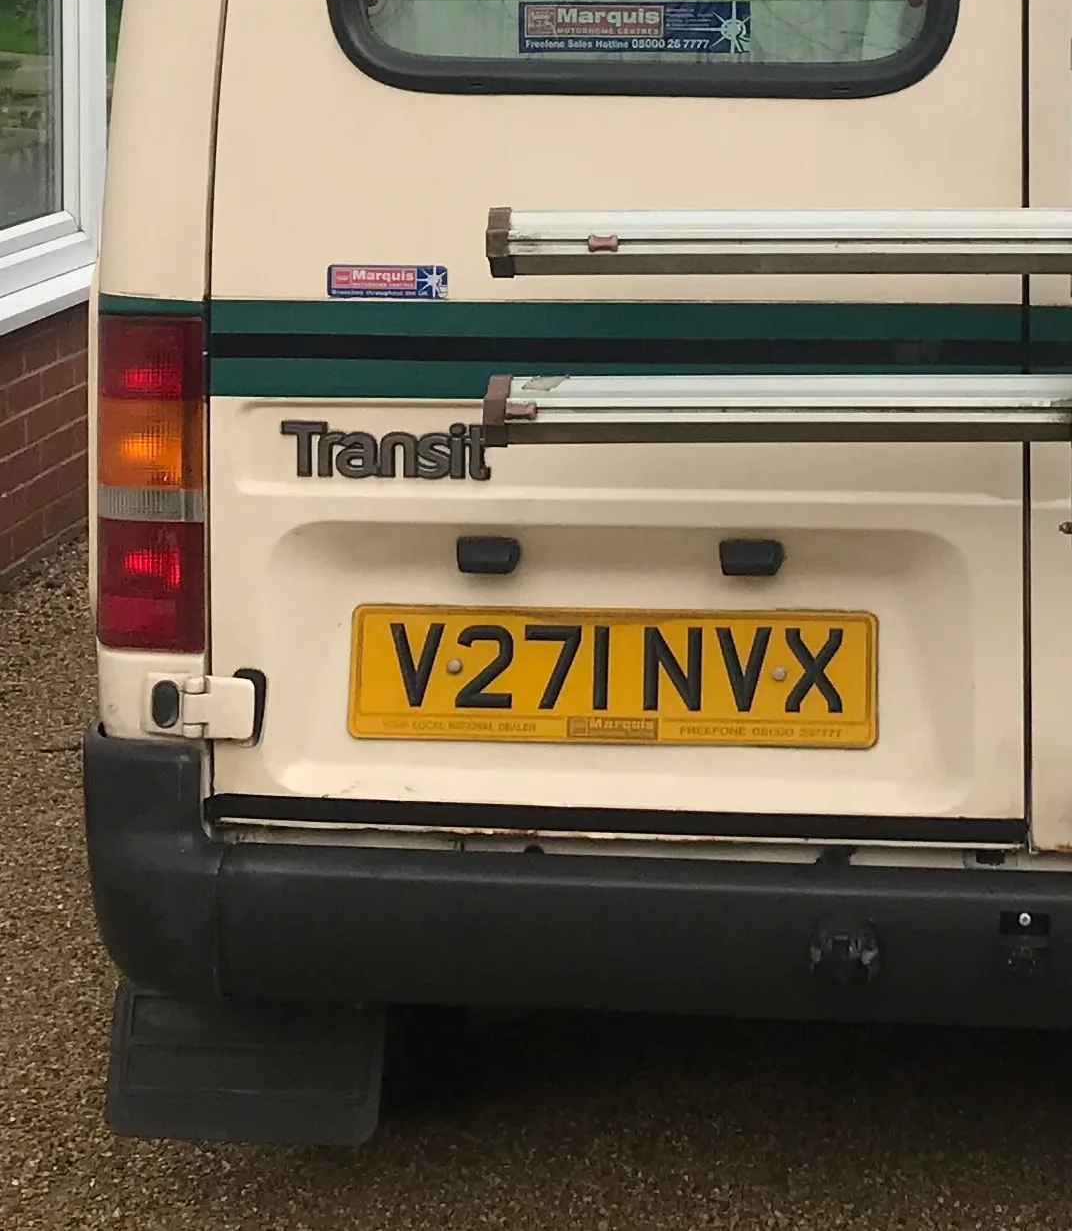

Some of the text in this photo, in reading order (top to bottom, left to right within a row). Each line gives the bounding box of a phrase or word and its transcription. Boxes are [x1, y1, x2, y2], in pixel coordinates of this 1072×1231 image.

[557, 8, 661, 28] Marquis
[567, 39, 593, 49] Sales
[595, 39, 629, 49] Hotline
[631, 38, 666, 49] 08000
[682, 38, 710, 49] 7777
[352, 269, 414, 283] Marquis
[280, 420, 492, 481] Transit
[389, 622, 844, 714] V271 NVX
[587, 718, 655, 732] Marquis
[679, 724, 746, 737] FREEFONE
